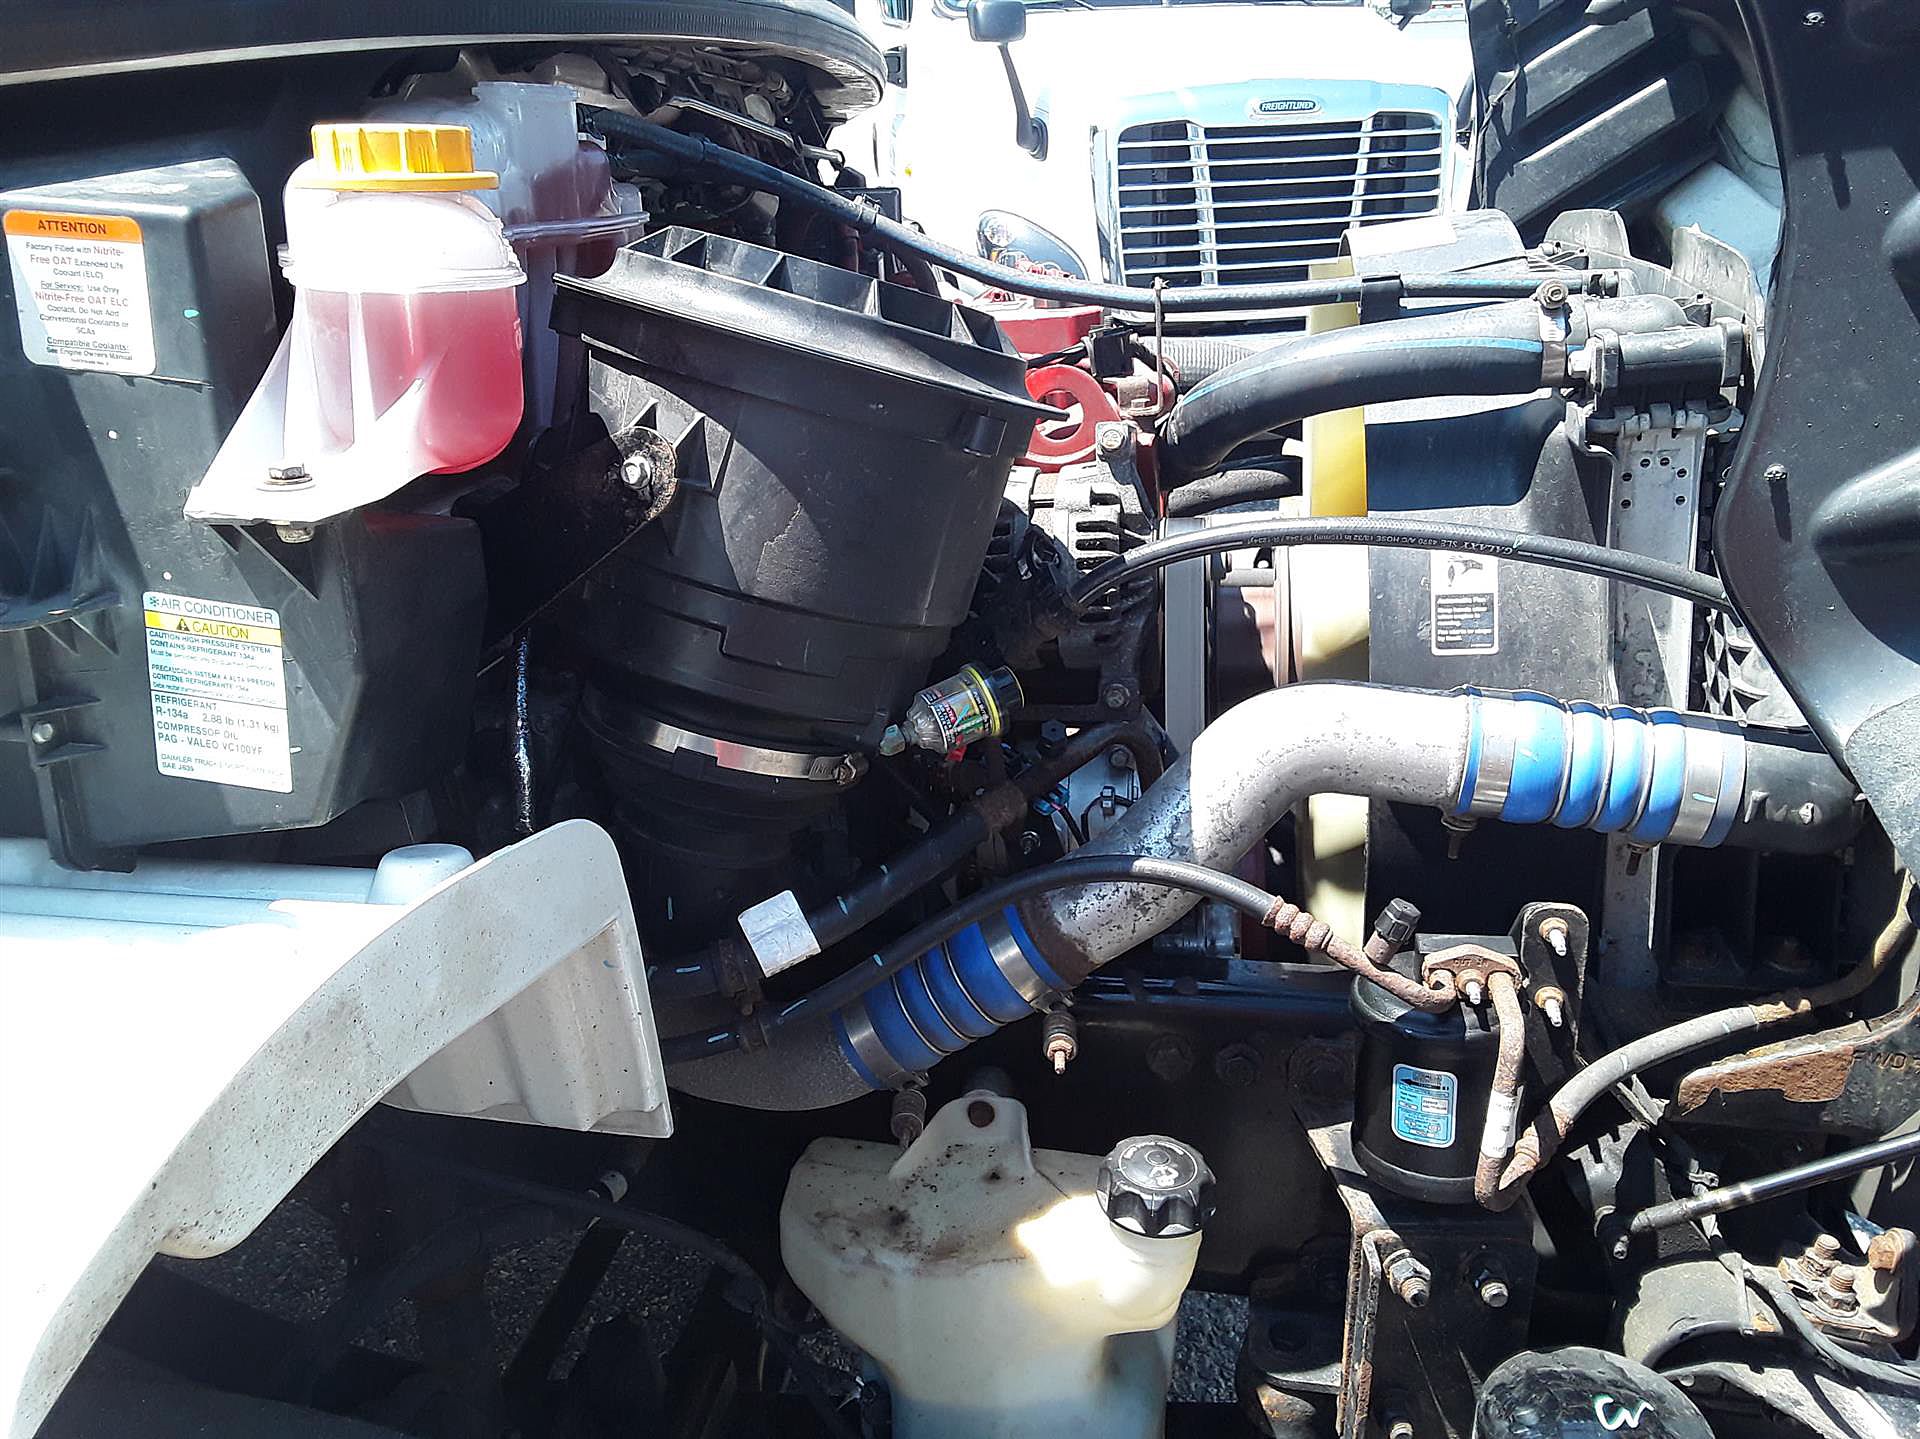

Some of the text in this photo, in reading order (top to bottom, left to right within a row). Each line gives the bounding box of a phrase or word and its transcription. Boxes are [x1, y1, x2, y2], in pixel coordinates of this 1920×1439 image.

[1261, 101, 1315, 111] FREIGHTLINER
[38, 219, 107, 234] ATTENTION
[30, 254, 51, 265] Free
[52, 255, 72, 265] OAT
[87, 295, 107, 305] OAT
[110, 297, 128, 307] ELC
[88, 317, 121, 328] Coolants
[46, 336, 90, 348] Compatible
[60, 348, 82, 357] Engine
[1375, 534, 1400, 543] HOSE
[1462, 540, 1513, 555] GALAXY
[161, 597, 274, 625] AIR CONDITIONER
[192, 621, 249, 640] CAUTION
[149, 630, 181, 640] CAUTION
[182, 633, 200, 643] HIGH
[201, 638, 239, 649] PRESSURE
[150, 639, 186, 651] CONTAINS
[187, 644, 236, 658] REFRIGERANT
[152, 672, 184, 684] CONTIENE
[185, 677, 233, 689] REFRIGERANTE
[154, 694, 218, 711] REFRIGERANT
[155, 706, 189, 720] R-134a
[202, 713, 223, 725] 2.88
[225, 715, 235, 726] lb
[237, 718, 261, 729] (1.31
[158, 732, 178, 744] PAG
[187, 735, 219, 750] VALEO
[223, 730, 239, 741] OIL
[161, 753, 193, 764] DAIMLER
